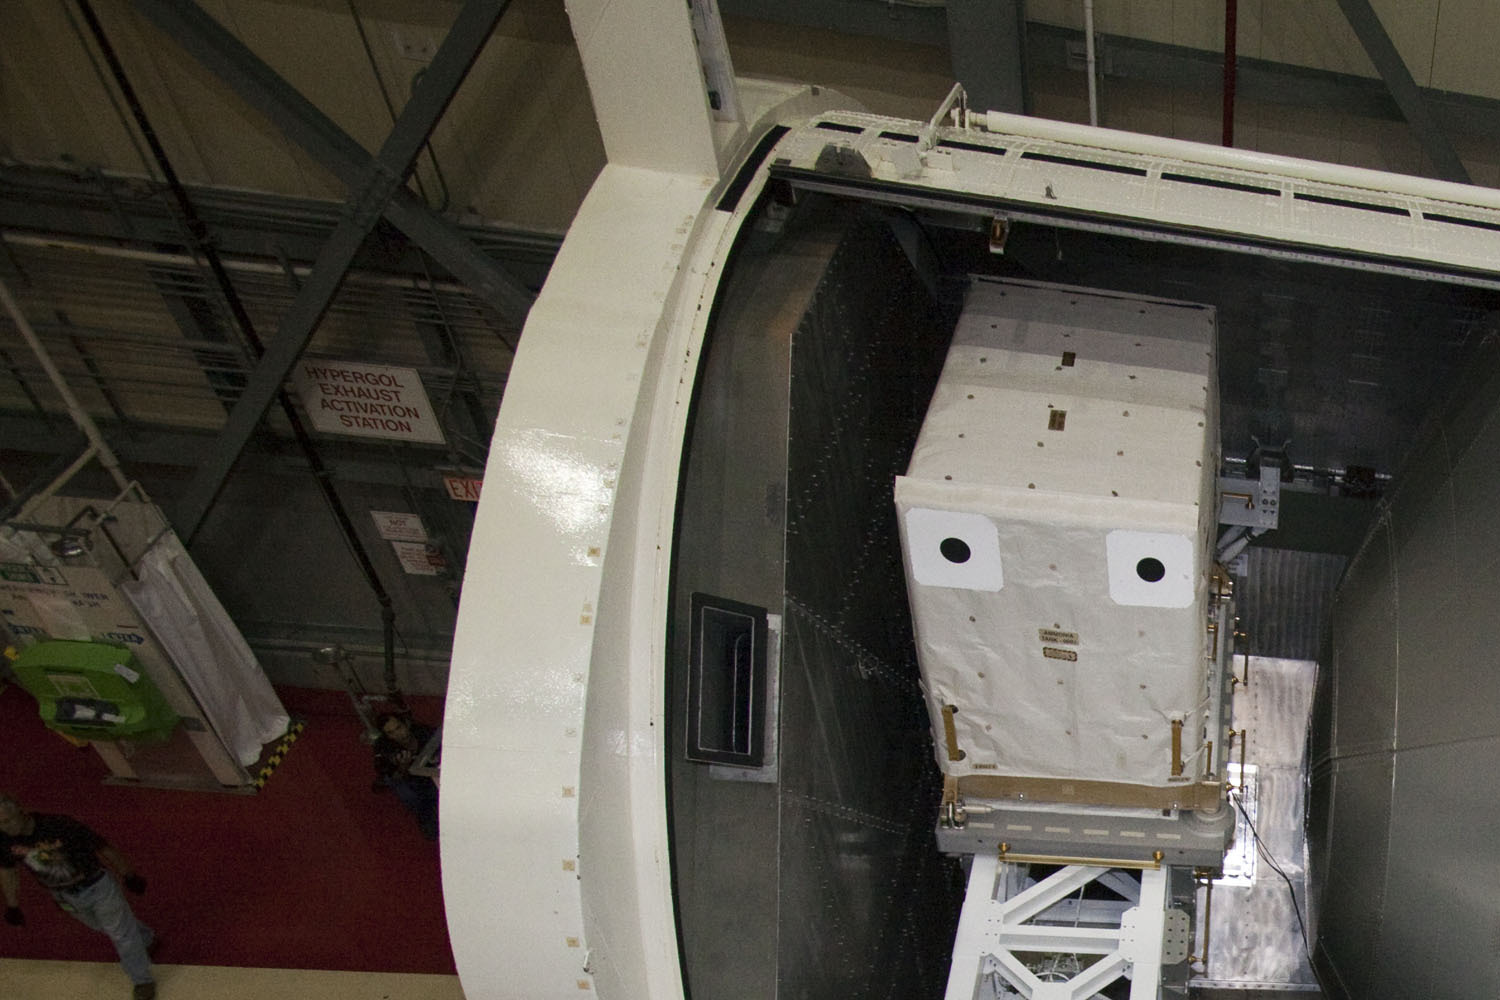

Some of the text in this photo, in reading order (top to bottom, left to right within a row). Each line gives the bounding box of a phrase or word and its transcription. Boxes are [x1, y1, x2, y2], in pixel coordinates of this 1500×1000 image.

[305, 367, 404, 388] HYPERGOL
[319, 383, 401, 402] EXHAUST
[321, 398, 420, 419] ACTIVATION
[340, 415, 412, 432] STATION
